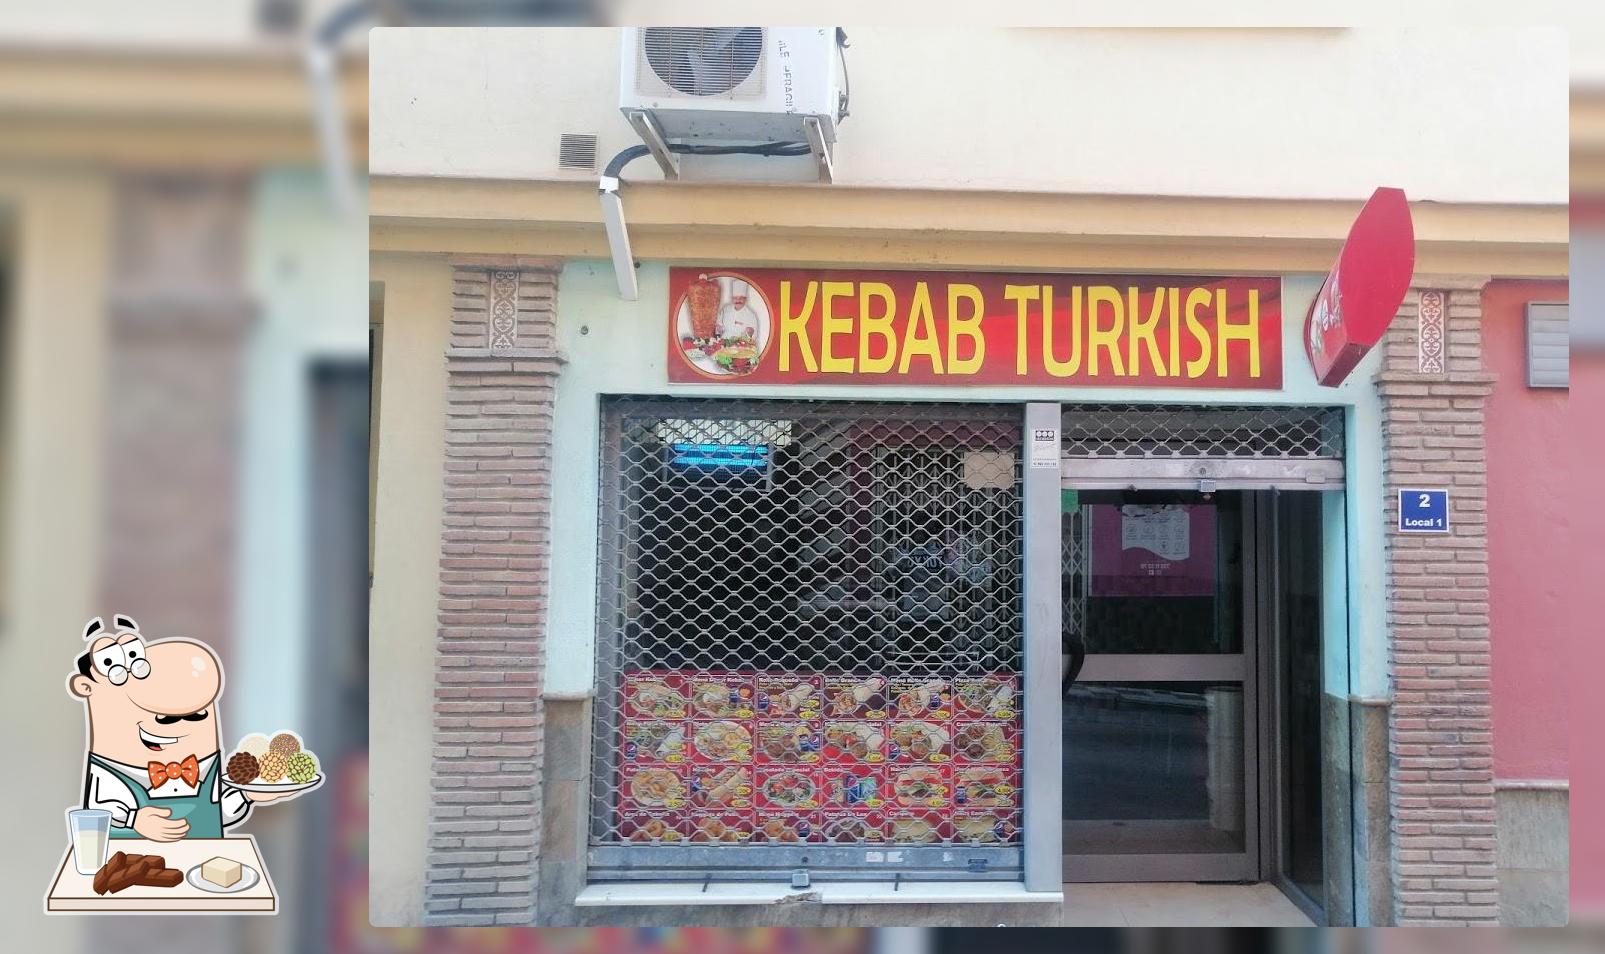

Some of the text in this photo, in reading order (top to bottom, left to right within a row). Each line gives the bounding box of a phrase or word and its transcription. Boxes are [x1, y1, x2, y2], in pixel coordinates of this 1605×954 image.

[778, 281, 986, 376] KEBAB
[1004, 285, 1260, 379] TURKISH
[1419, 494, 1430, 507] 2
[1405, 518, 1442, 527] Local 1
